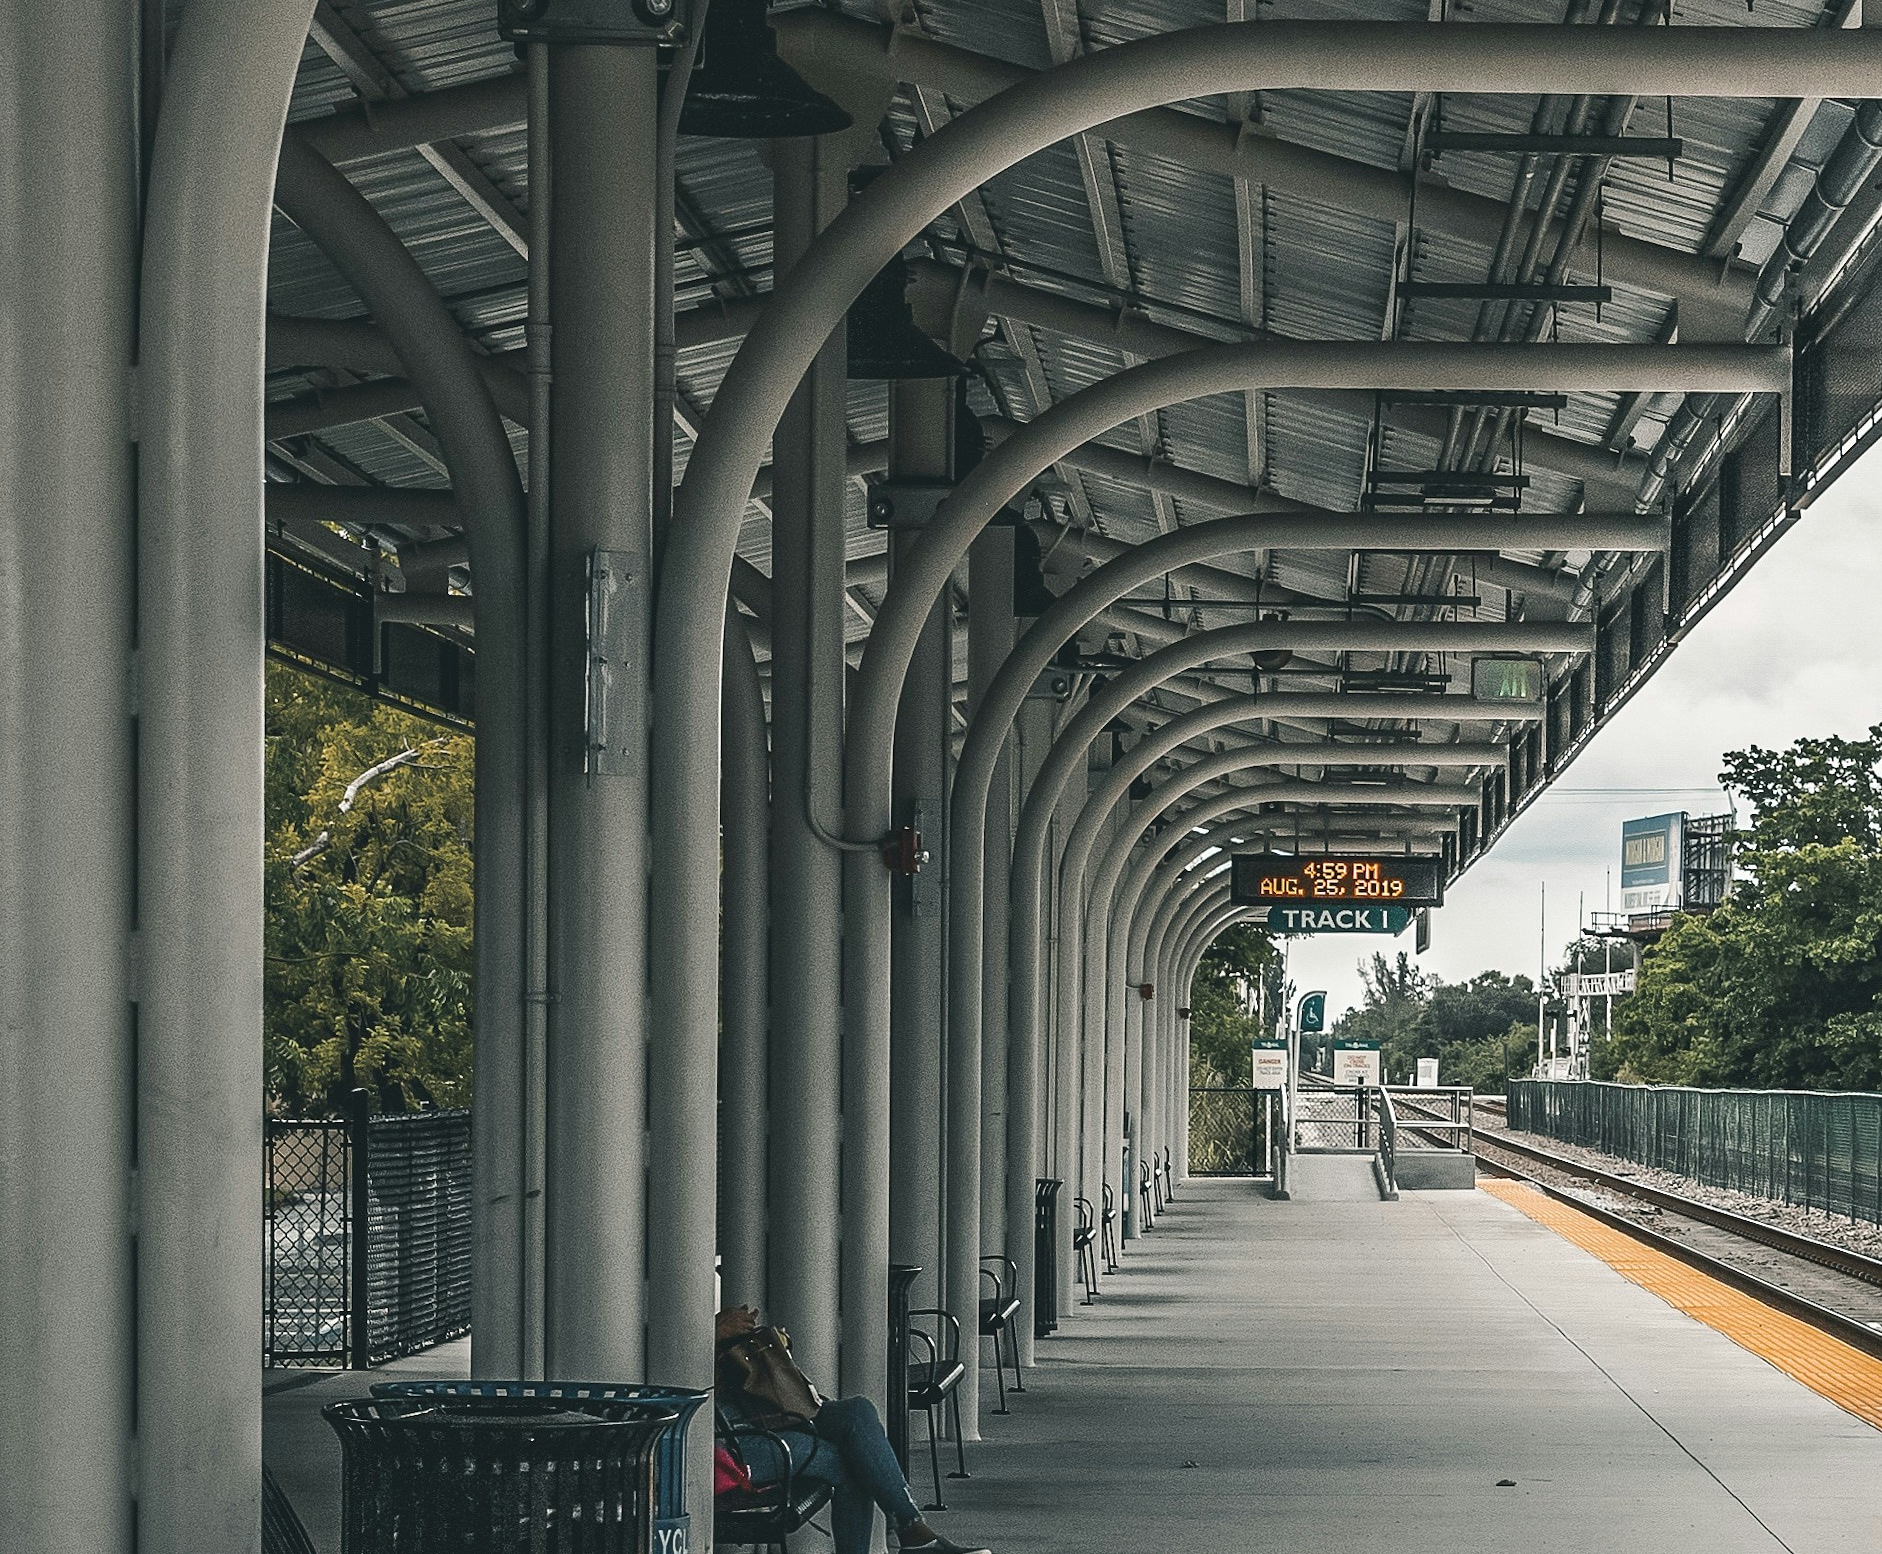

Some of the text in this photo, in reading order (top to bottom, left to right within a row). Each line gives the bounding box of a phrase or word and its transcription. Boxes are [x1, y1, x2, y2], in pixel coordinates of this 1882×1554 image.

[1304, 862, 1380, 880] 4:59 PM
[1260, 878, 1403, 896] AUG. 25, 2019
[1282, 909, 1388, 929] TRACK 1
